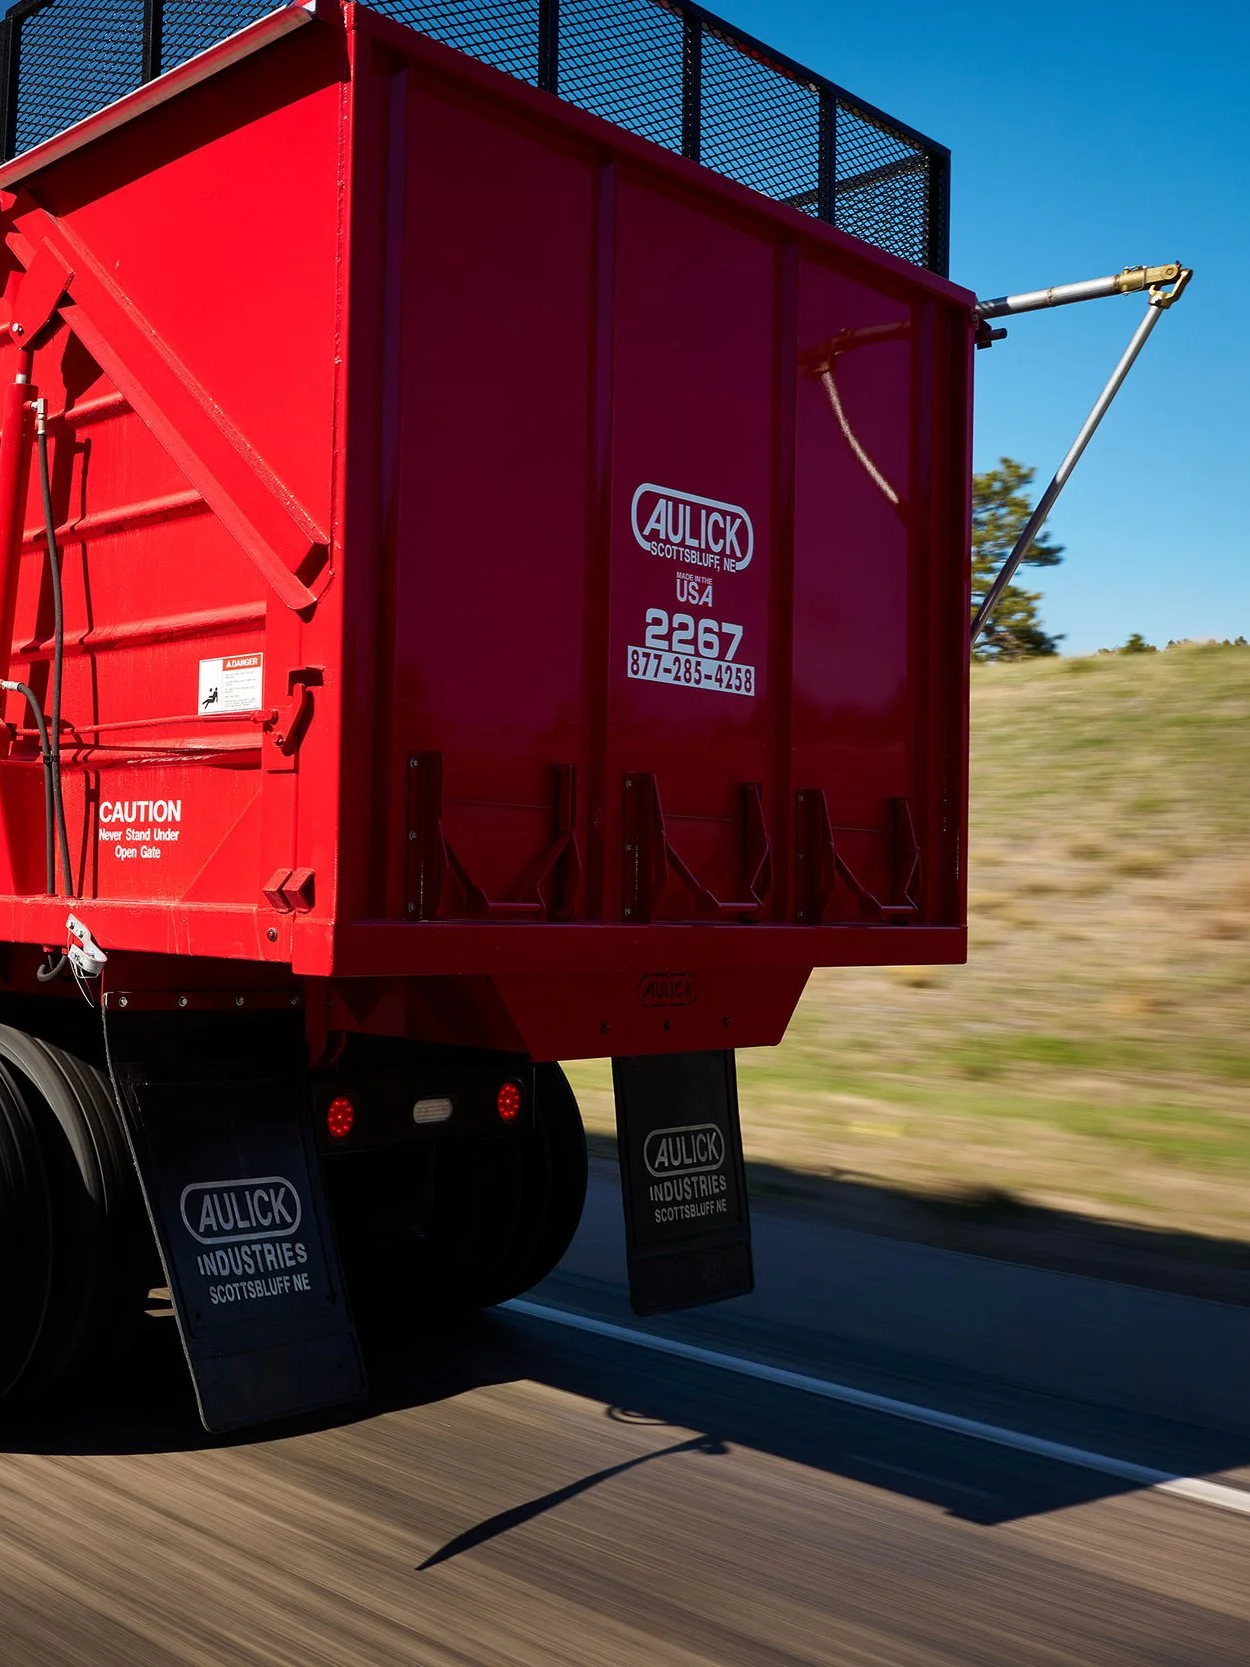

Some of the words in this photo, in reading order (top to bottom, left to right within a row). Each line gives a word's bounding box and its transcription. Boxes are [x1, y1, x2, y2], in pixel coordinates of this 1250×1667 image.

[643, 499, 742, 557] AULICK
[651, 541, 720, 572] SCOTTSBLUFF,
[723, 557, 736, 572] NE
[676, 571, 693, 581] MADE
[701, 576, 713, 585] THE
[676, 579, 713, 607] USA
[645, 608, 743, 661] 2267
[231, 657, 258, 667] DANGER
[631, 650, 752, 693] 877-285-4258
[99, 800, 181, 823] CAUTION
[99, 828, 122, 840] Never
[125, 828, 150, 841] Stand
[153, 828, 179, 841] Under
[115, 845, 137, 861] Open
[140, 845, 161, 858] Gate
[643, 980, 692, 999] AULICK
[654, 1131, 719, 1168] AULICK
[649, 1174, 727, 1201] INDUSTRIES
[198, 1187, 293, 1233] AULICK
[654, 1200, 715, 1223] SCOTTSBLUFF
[716, 1198, 727, 1213] NE
[196, 1242, 308, 1276] INDUSTRIES
[209, 1275, 291, 1305] SCOTTSBLUFF
[293, 1272, 311, 1292] NE
